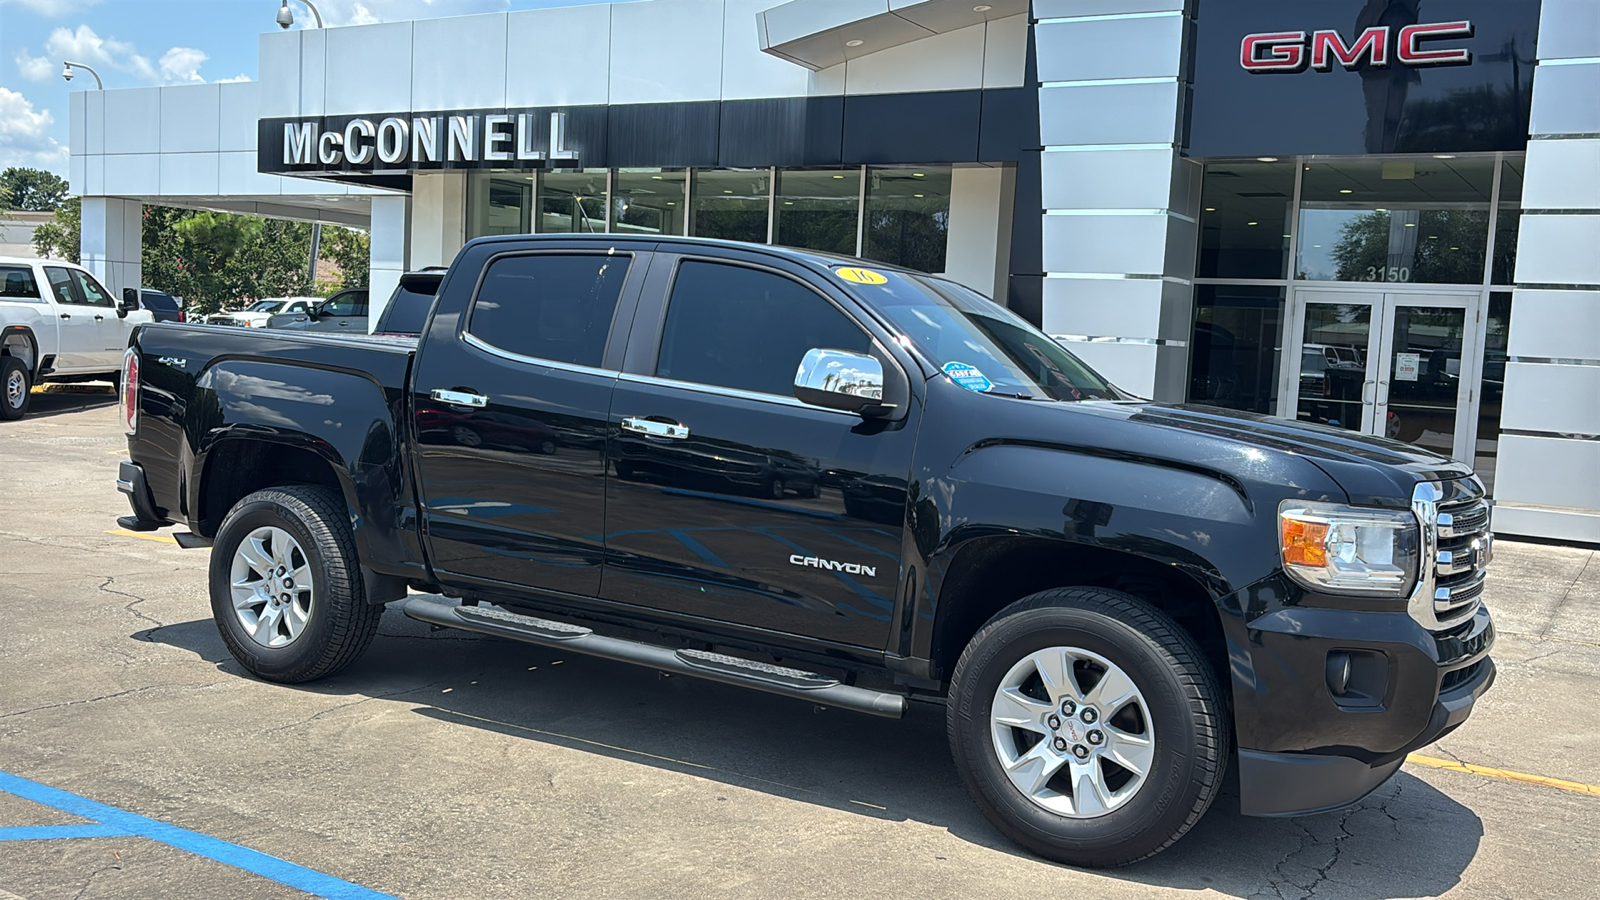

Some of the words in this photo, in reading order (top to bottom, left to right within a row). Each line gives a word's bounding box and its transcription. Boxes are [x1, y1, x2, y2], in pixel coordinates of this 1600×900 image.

[1240, 20, 1472, 70] GMC
[283, 112, 579, 165] McCONNELL
[1366, 266, 1410, 282] 3150
[789, 554, 876, 577] CANYON
[1067, 720, 1079, 742] GMC
